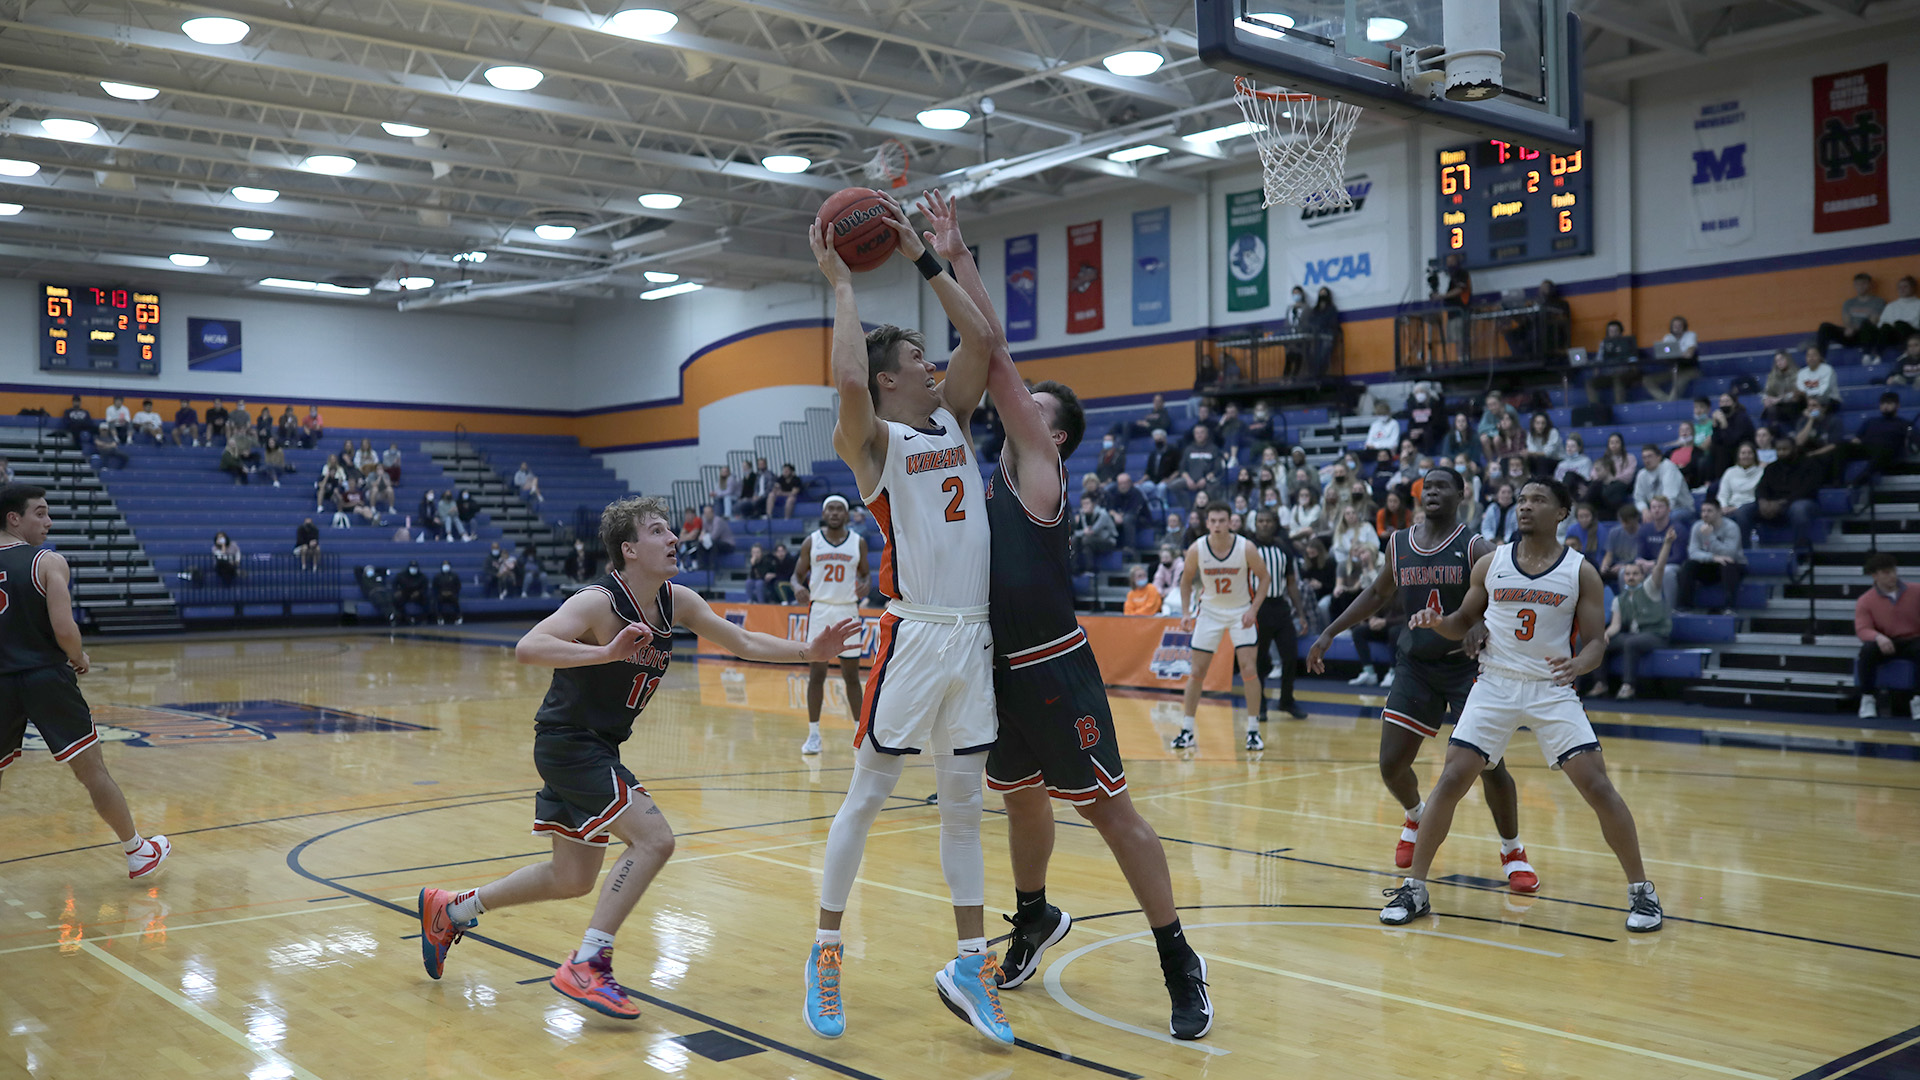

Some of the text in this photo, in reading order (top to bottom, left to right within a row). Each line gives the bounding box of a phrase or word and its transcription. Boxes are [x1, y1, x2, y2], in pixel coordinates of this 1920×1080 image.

[1692, 142, 1746, 185] M
[1441, 163, 1471, 195] 67
[1527, 170, 1540, 193] 2
[834, 204, 887, 237] Wilson
[1559, 210, 1572, 233] 6
[1303, 253, 1371, 286] NCAA
[47, 297, 73, 317] 67
[135, 304, 160, 324] 63
[118, 314, 129, 330] 2
[142, 345, 153, 360] 6
[941, 476, 966, 522] 2
[824, 564, 845, 583] 20
[1400, 565, 1463, 586] BENEDICTINE
[1215, 578, 1232, 594] 12
[1494, 588, 1568, 607] WHEATON
[1426, 589, 1444, 616] 4
[1515, 608, 1537, 641] 3
[1074, 715, 1101, 751] B
